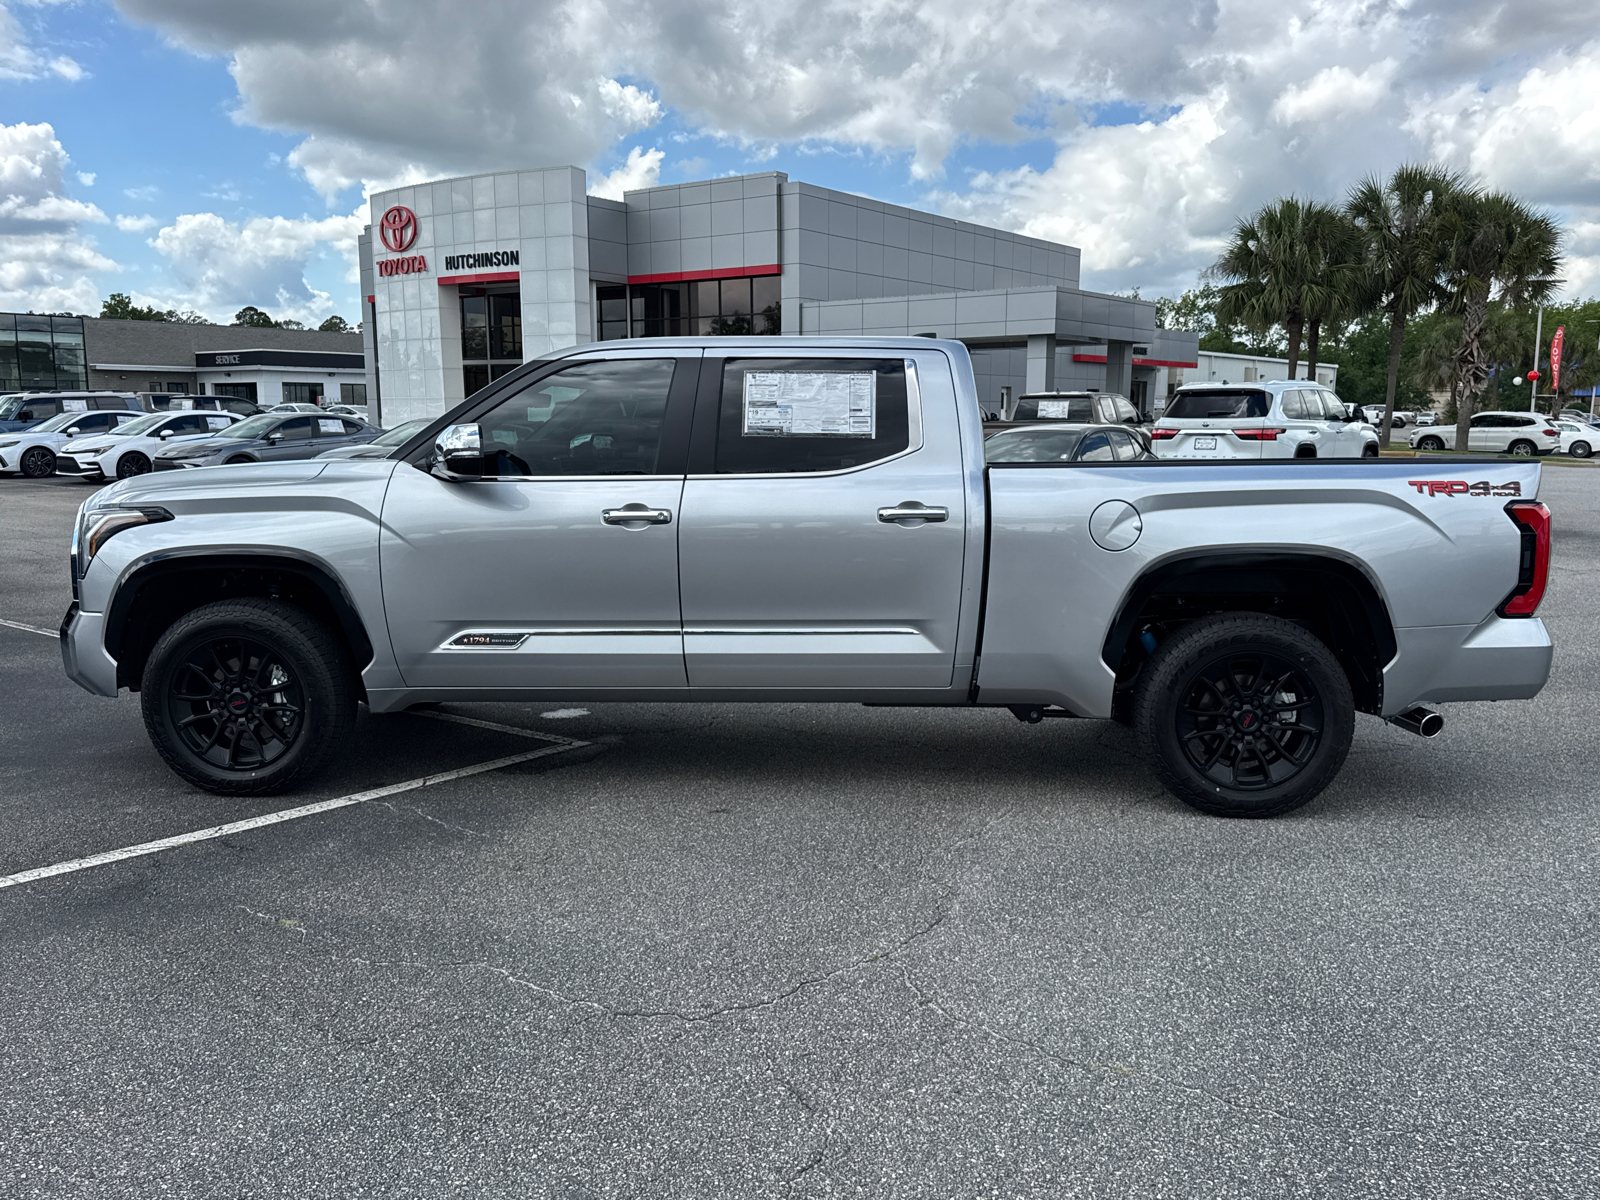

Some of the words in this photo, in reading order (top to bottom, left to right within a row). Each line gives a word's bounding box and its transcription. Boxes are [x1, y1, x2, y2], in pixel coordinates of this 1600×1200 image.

[376, 255, 427, 277] TOYOTA
[445, 250, 519, 270] HUTCHINSON
[215, 355, 240, 364] SERVICE
[1408, 481, 1470, 497] TRD
